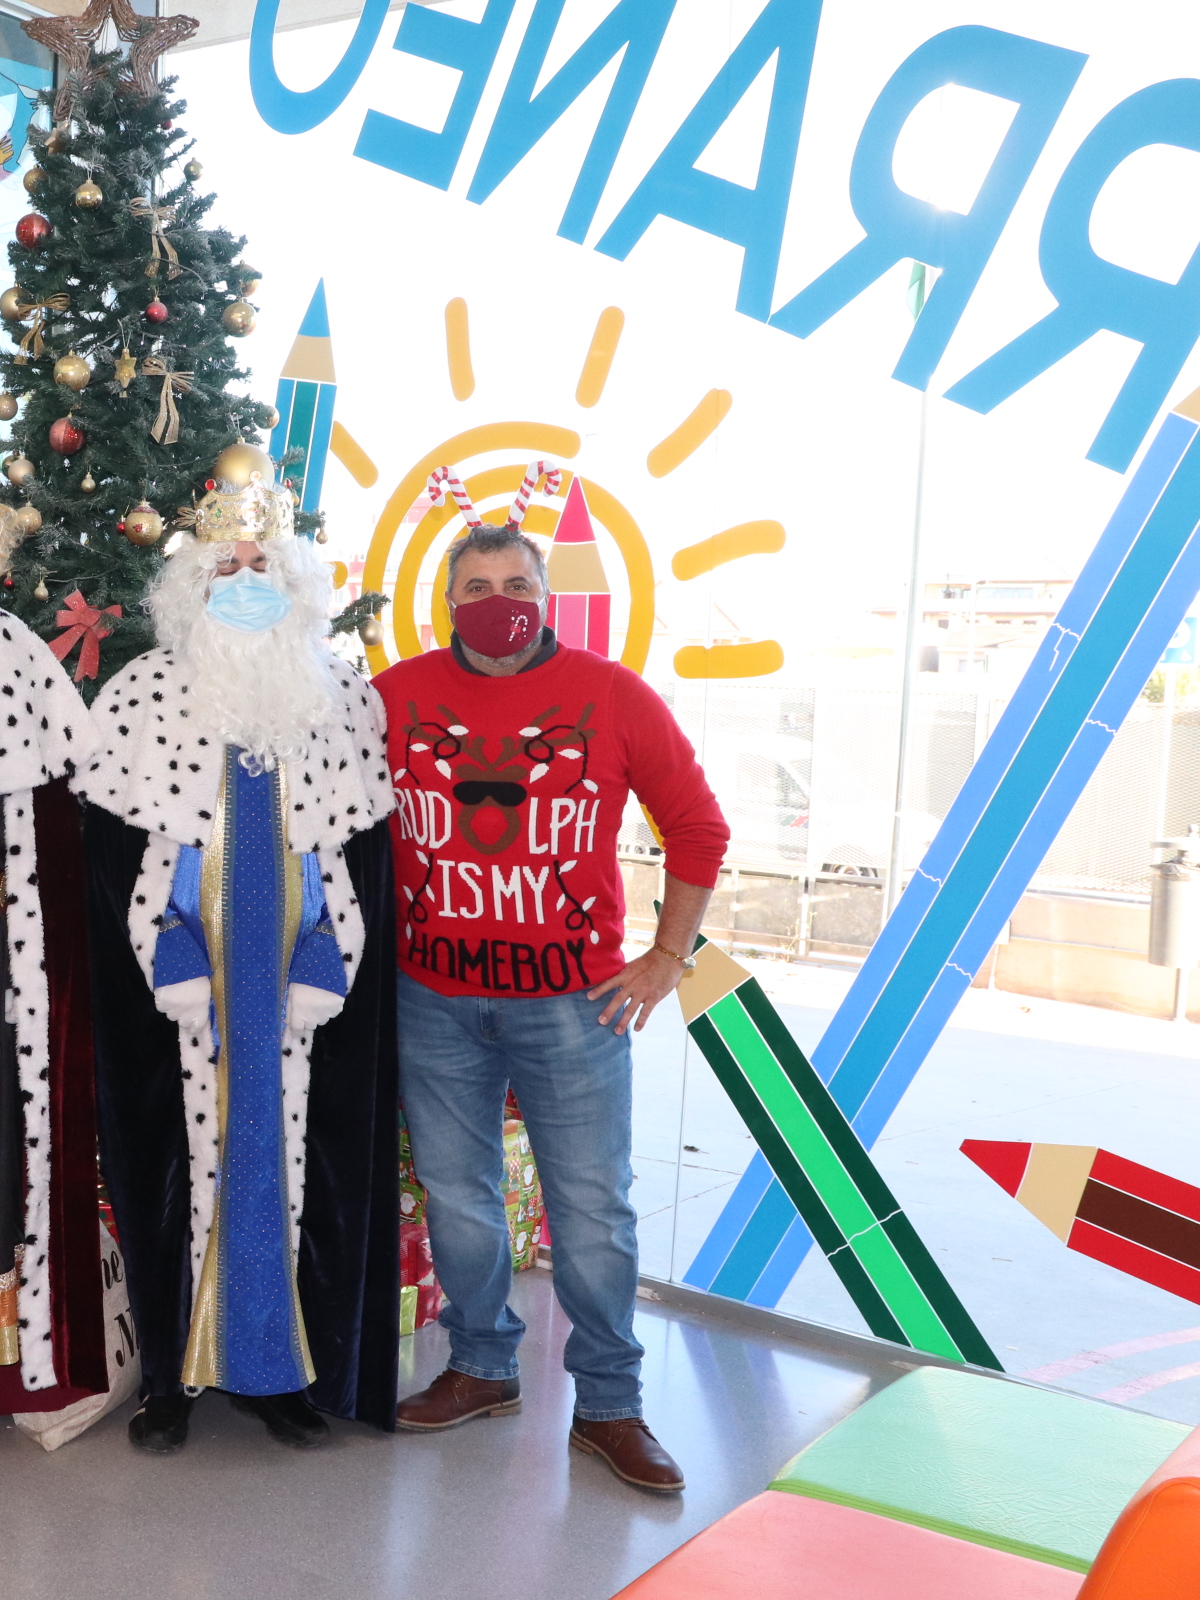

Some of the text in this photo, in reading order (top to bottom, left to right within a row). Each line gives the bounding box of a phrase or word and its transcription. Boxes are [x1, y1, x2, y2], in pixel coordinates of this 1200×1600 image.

[437, 859, 549, 924] IS MY
[408, 929, 590, 993] HOMEBOY
